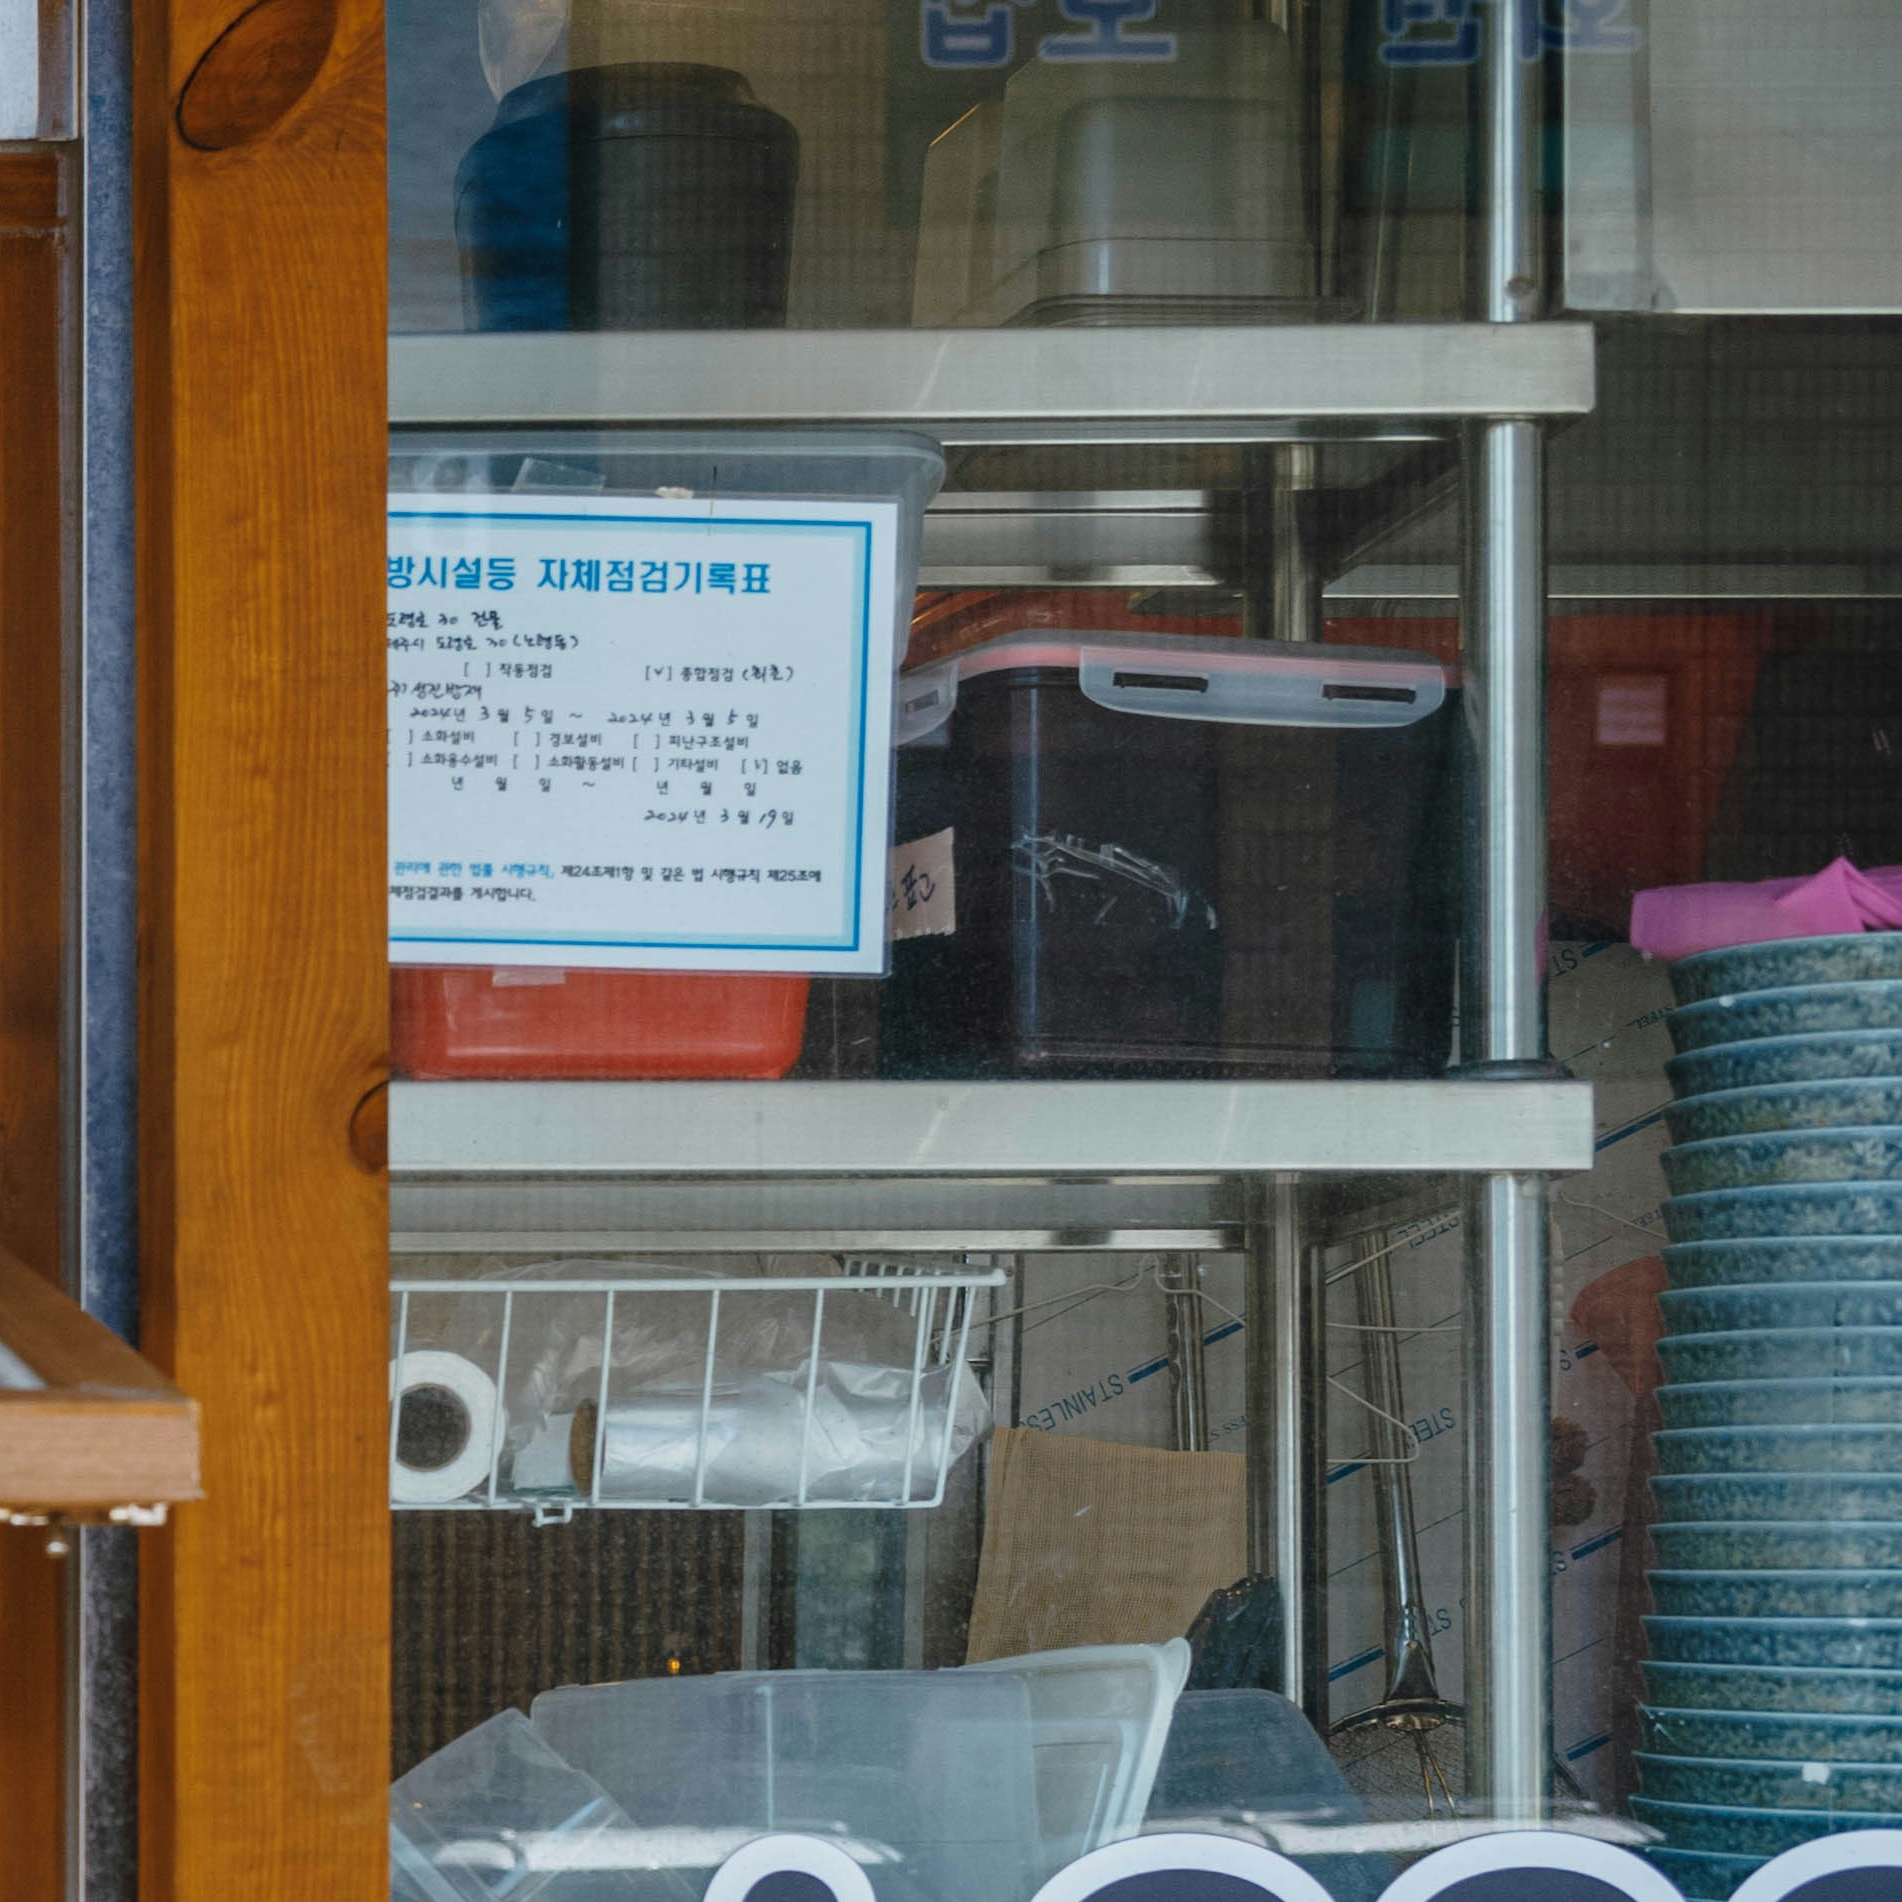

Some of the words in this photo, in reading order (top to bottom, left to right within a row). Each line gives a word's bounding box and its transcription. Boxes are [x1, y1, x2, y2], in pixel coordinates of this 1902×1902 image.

[537, 558, 771, 595] 자체점검기록표
[499, 662, 553, 679] 작동점검
[680, 666, 734, 683] 종합점검
[497, 708, 510, 724] 월
[540, 709, 554, 725] 일
[702, 712, 715, 728] 월
[745, 713, 759, 729] 일
[422, 729, 475, 746] 소화설비
[549, 732, 602, 748] 경보설비
[668, 735, 749, 752] 피난구조설비
[420, 752, 498, 769] 소화용수설비
[548, 755, 625, 772] 소화활동설비
[668, 757, 719, 774] 기타설비
[451, 776, 464, 791] 년
[495, 776, 507, 792] 월
[538, 777, 551, 793] 일
[656, 780, 669, 796] 년
[700, 781, 712, 796] 월
[743, 781, 757, 797] 일
[737, 809, 750, 825] 월
